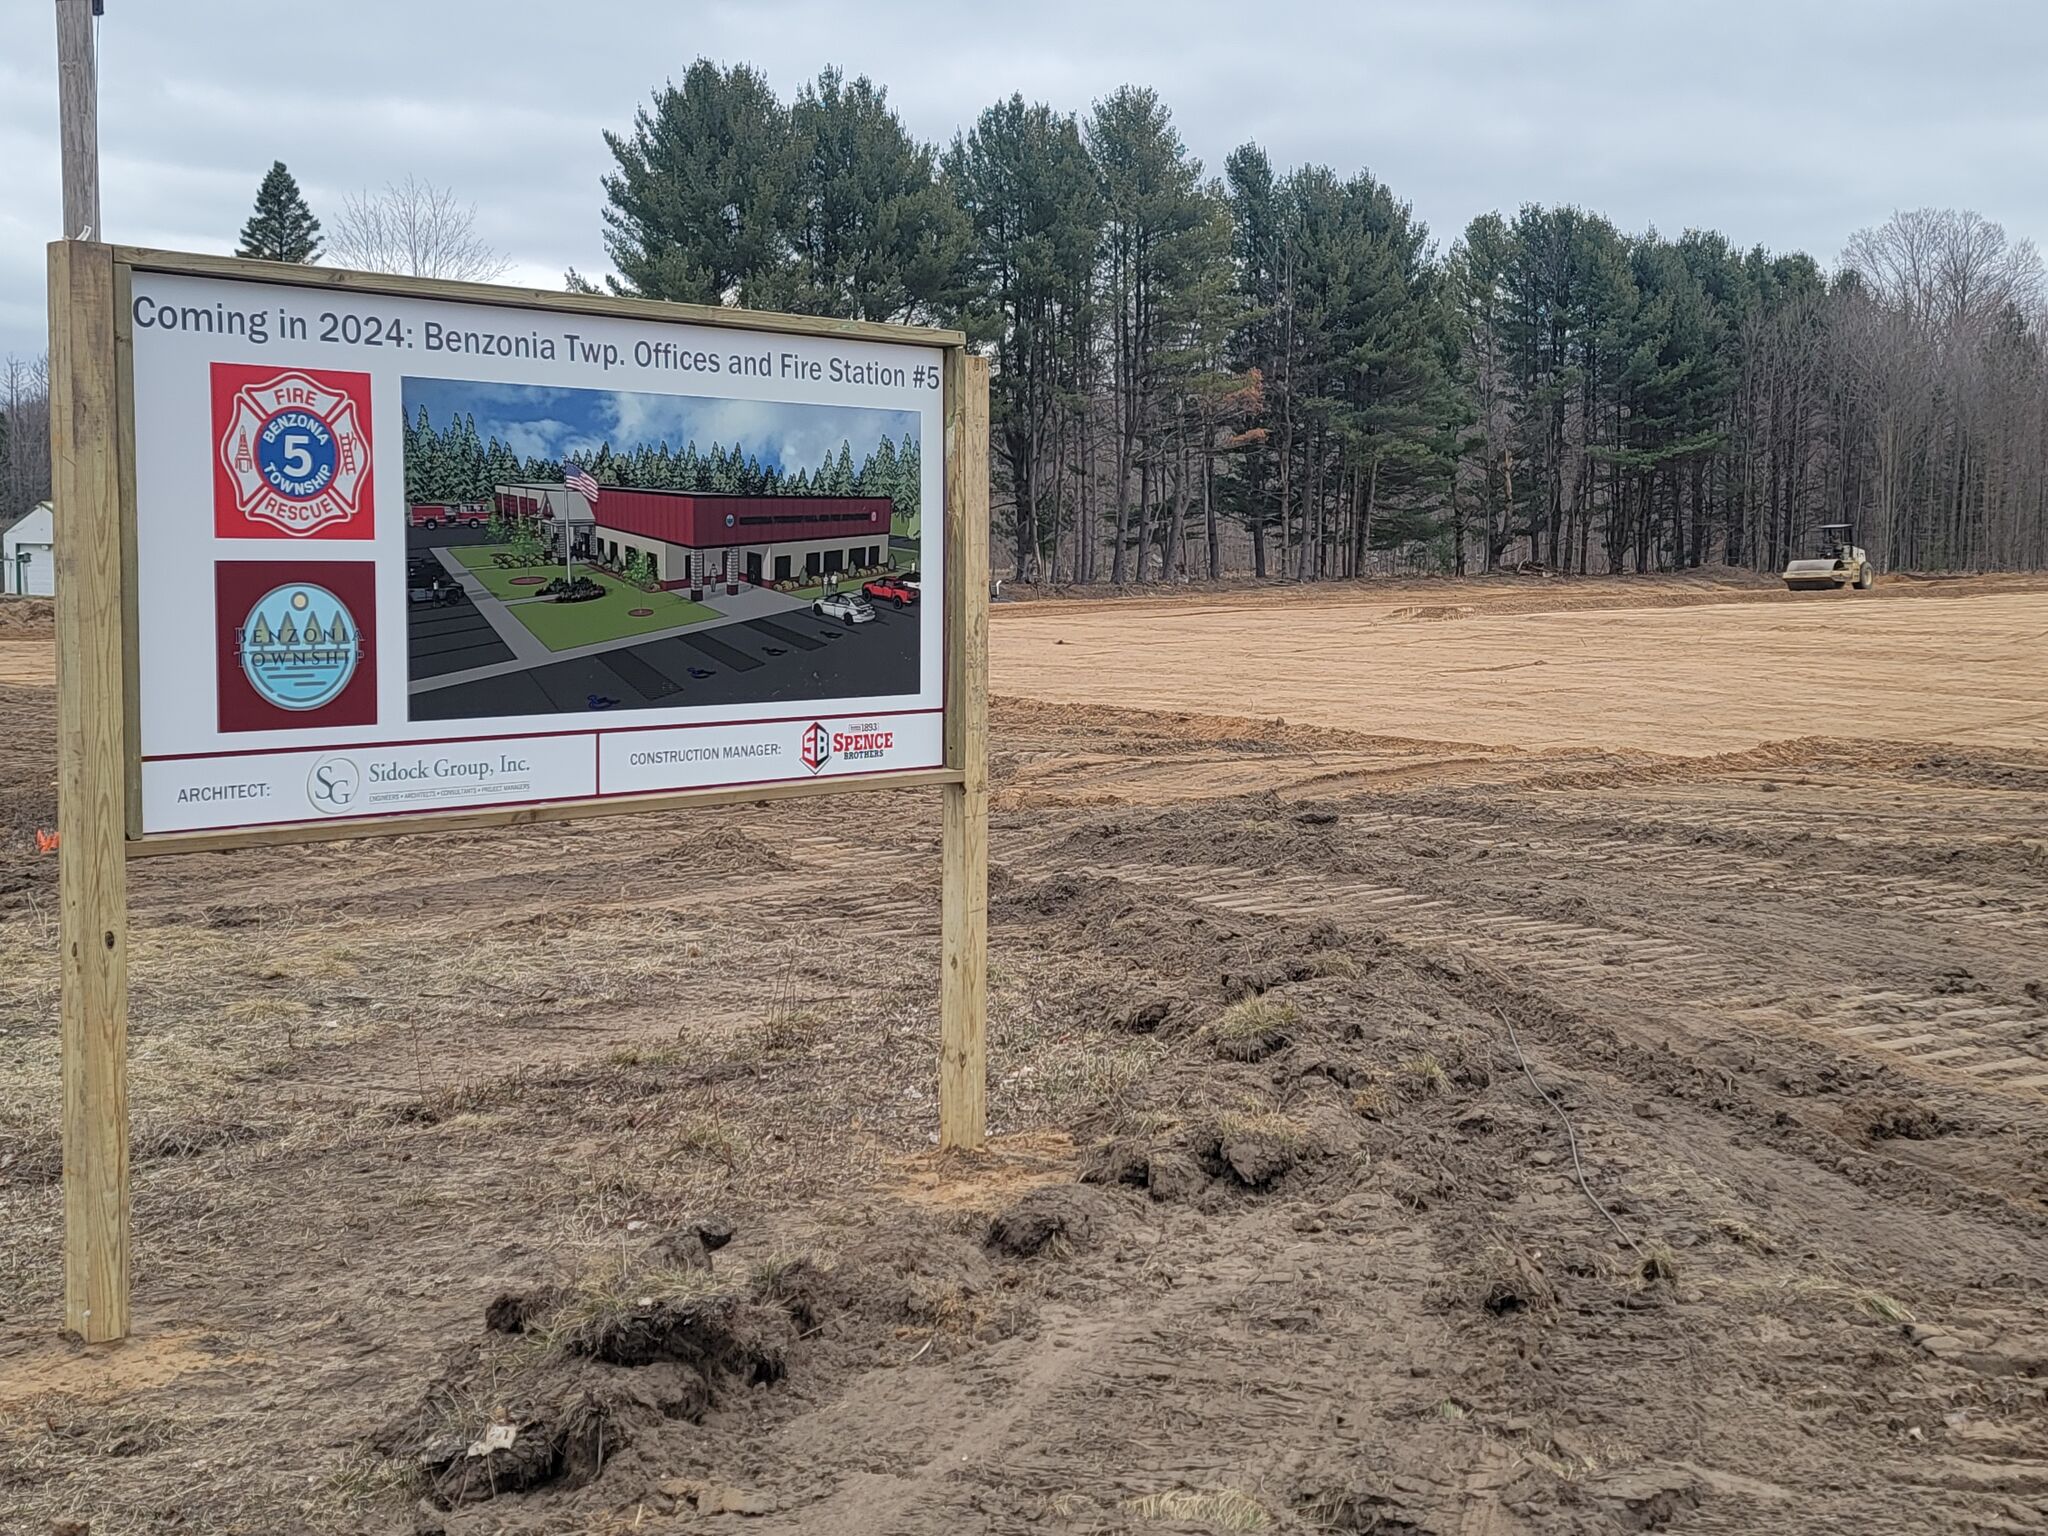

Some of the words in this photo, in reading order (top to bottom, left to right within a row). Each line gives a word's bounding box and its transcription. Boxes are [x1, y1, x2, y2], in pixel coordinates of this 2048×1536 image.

[132, 296, 269, 344] Coming
[278, 308, 307, 340] in
[319, 312, 413, 349] 2024:
[424, 321, 556, 360] Benzonia
[563, 334, 625, 371] Twp.
[634, 340, 721, 374] Offices
[728, 351, 772, 377] and
[780, 353, 822, 381] Fire
[828, 357, 905, 388] Station
[912, 365, 940, 390] #5
[273, 387, 318, 407] FIRE
[262, 414, 330, 446] BENZONIA
[283, 435, 313, 478] 5
[263, 462, 332, 496] TOWNSHIP
[264, 496, 334, 521] RESCUE
[235, 627, 366, 645] BENZONIA
[233, 650, 365, 668] TOWNSHIP
[861, 723, 878, 732] 1893
[833, 732, 893, 752] SPENCE
[630, 747, 719, 765] CONSTRUCTION
[723, 743, 782, 759] MANAGER:
[844, 749, 884, 760] BROTHERS
[368, 759, 429, 783] Sidock
[433, 758, 494, 780] Group,
[499, 755, 530, 773] Inc.
[177, 783, 270, 803] ARCHITECT:
[314, 766, 351, 805] SG
[369, 794, 400, 802] ENGINEERS
[404, 791, 436, 799] ARCHITECTS
[440, 788, 477, 797] CONSULTANTS
